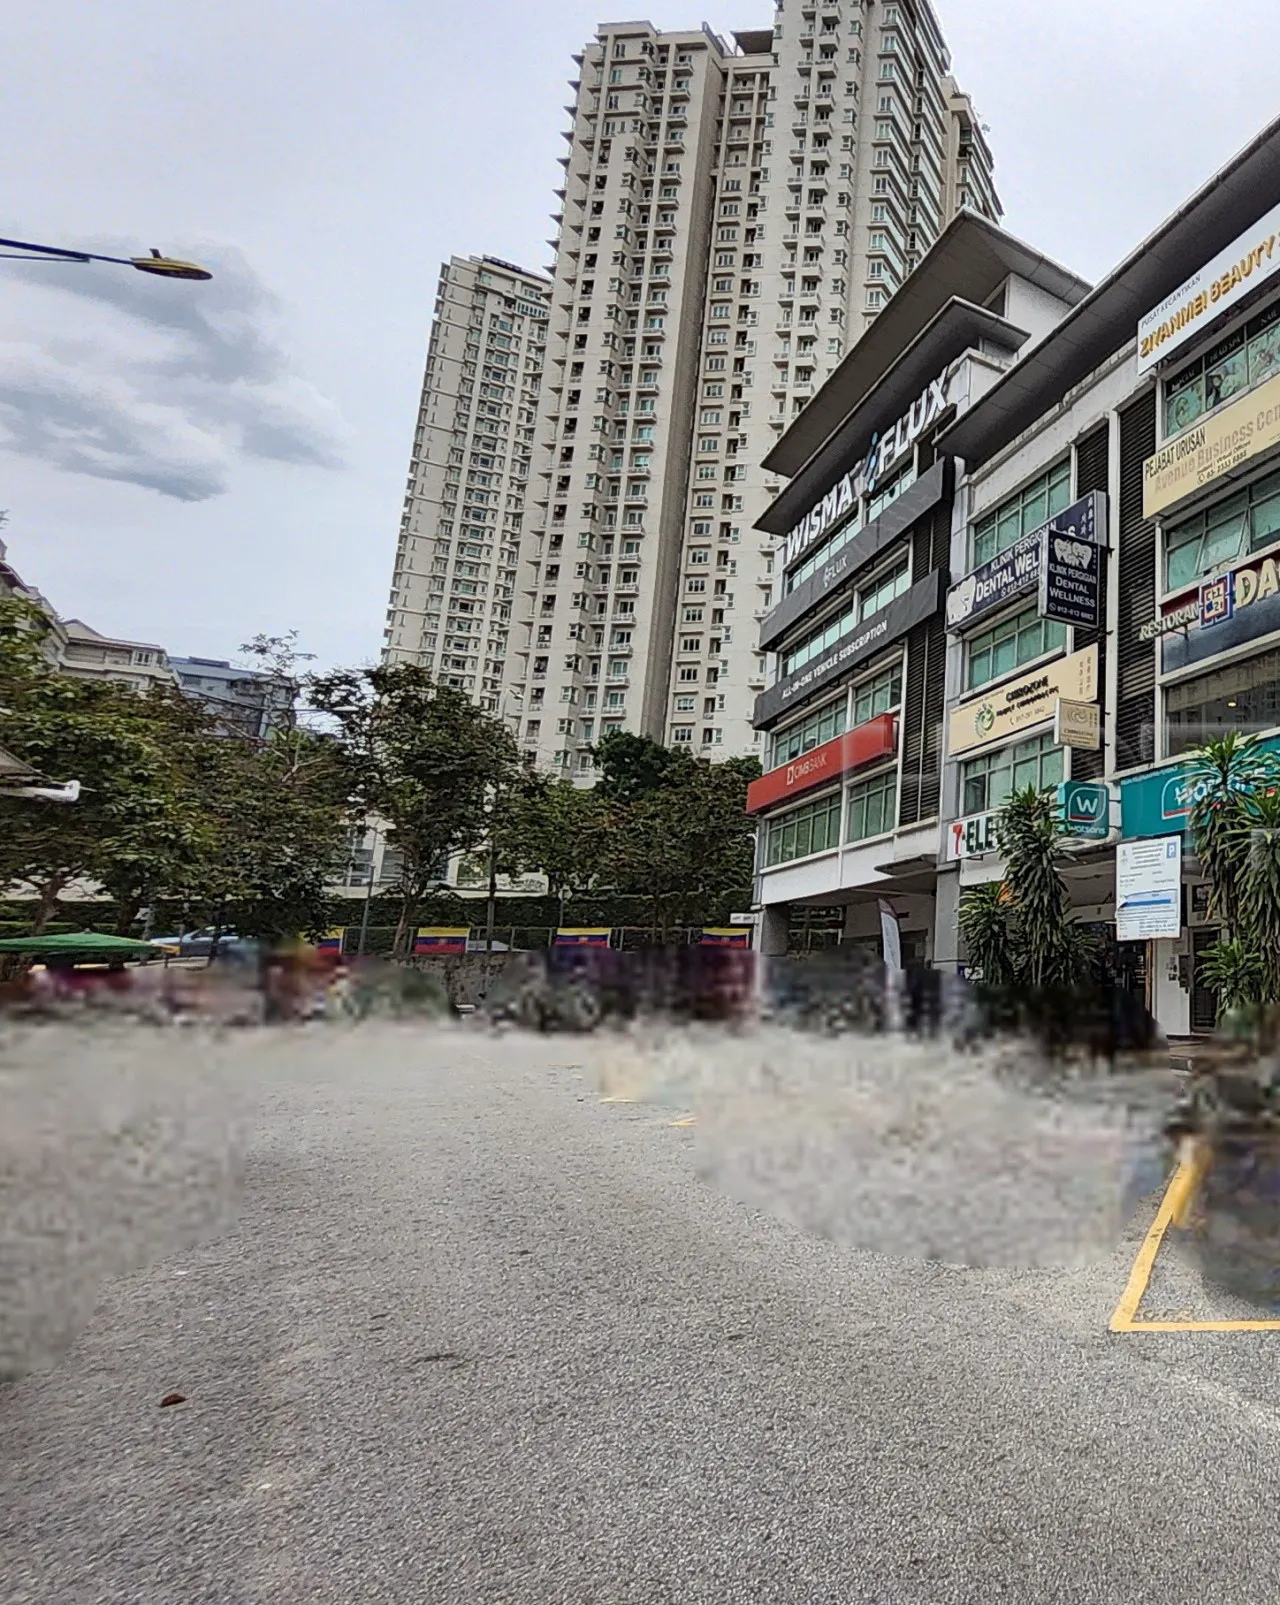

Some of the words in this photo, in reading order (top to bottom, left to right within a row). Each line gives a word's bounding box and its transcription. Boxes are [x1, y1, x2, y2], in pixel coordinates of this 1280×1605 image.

[1210, 235, 1275, 303] BEAUTY
[787, 473, 852, 565] WISMA
[879, 366, 949, 476] FLUX
[1145, 442, 1175, 481] PEJABAT
[1176, 426, 1206, 462] URUSAN
[1155, 459, 1196, 494] Avenue
[1197, 421, 1254, 467] Business
[976, 566, 1015, 603] DENTAL
[1049, 586, 1096, 608] WELLNESS
[1055, 576, 1090, 595] DENTAL
[839, 620, 887, 661] SUBSCRIPTION
[1139, 600, 1200, 641] RESTORAN
[1068, 823, 1106, 836] watsons
